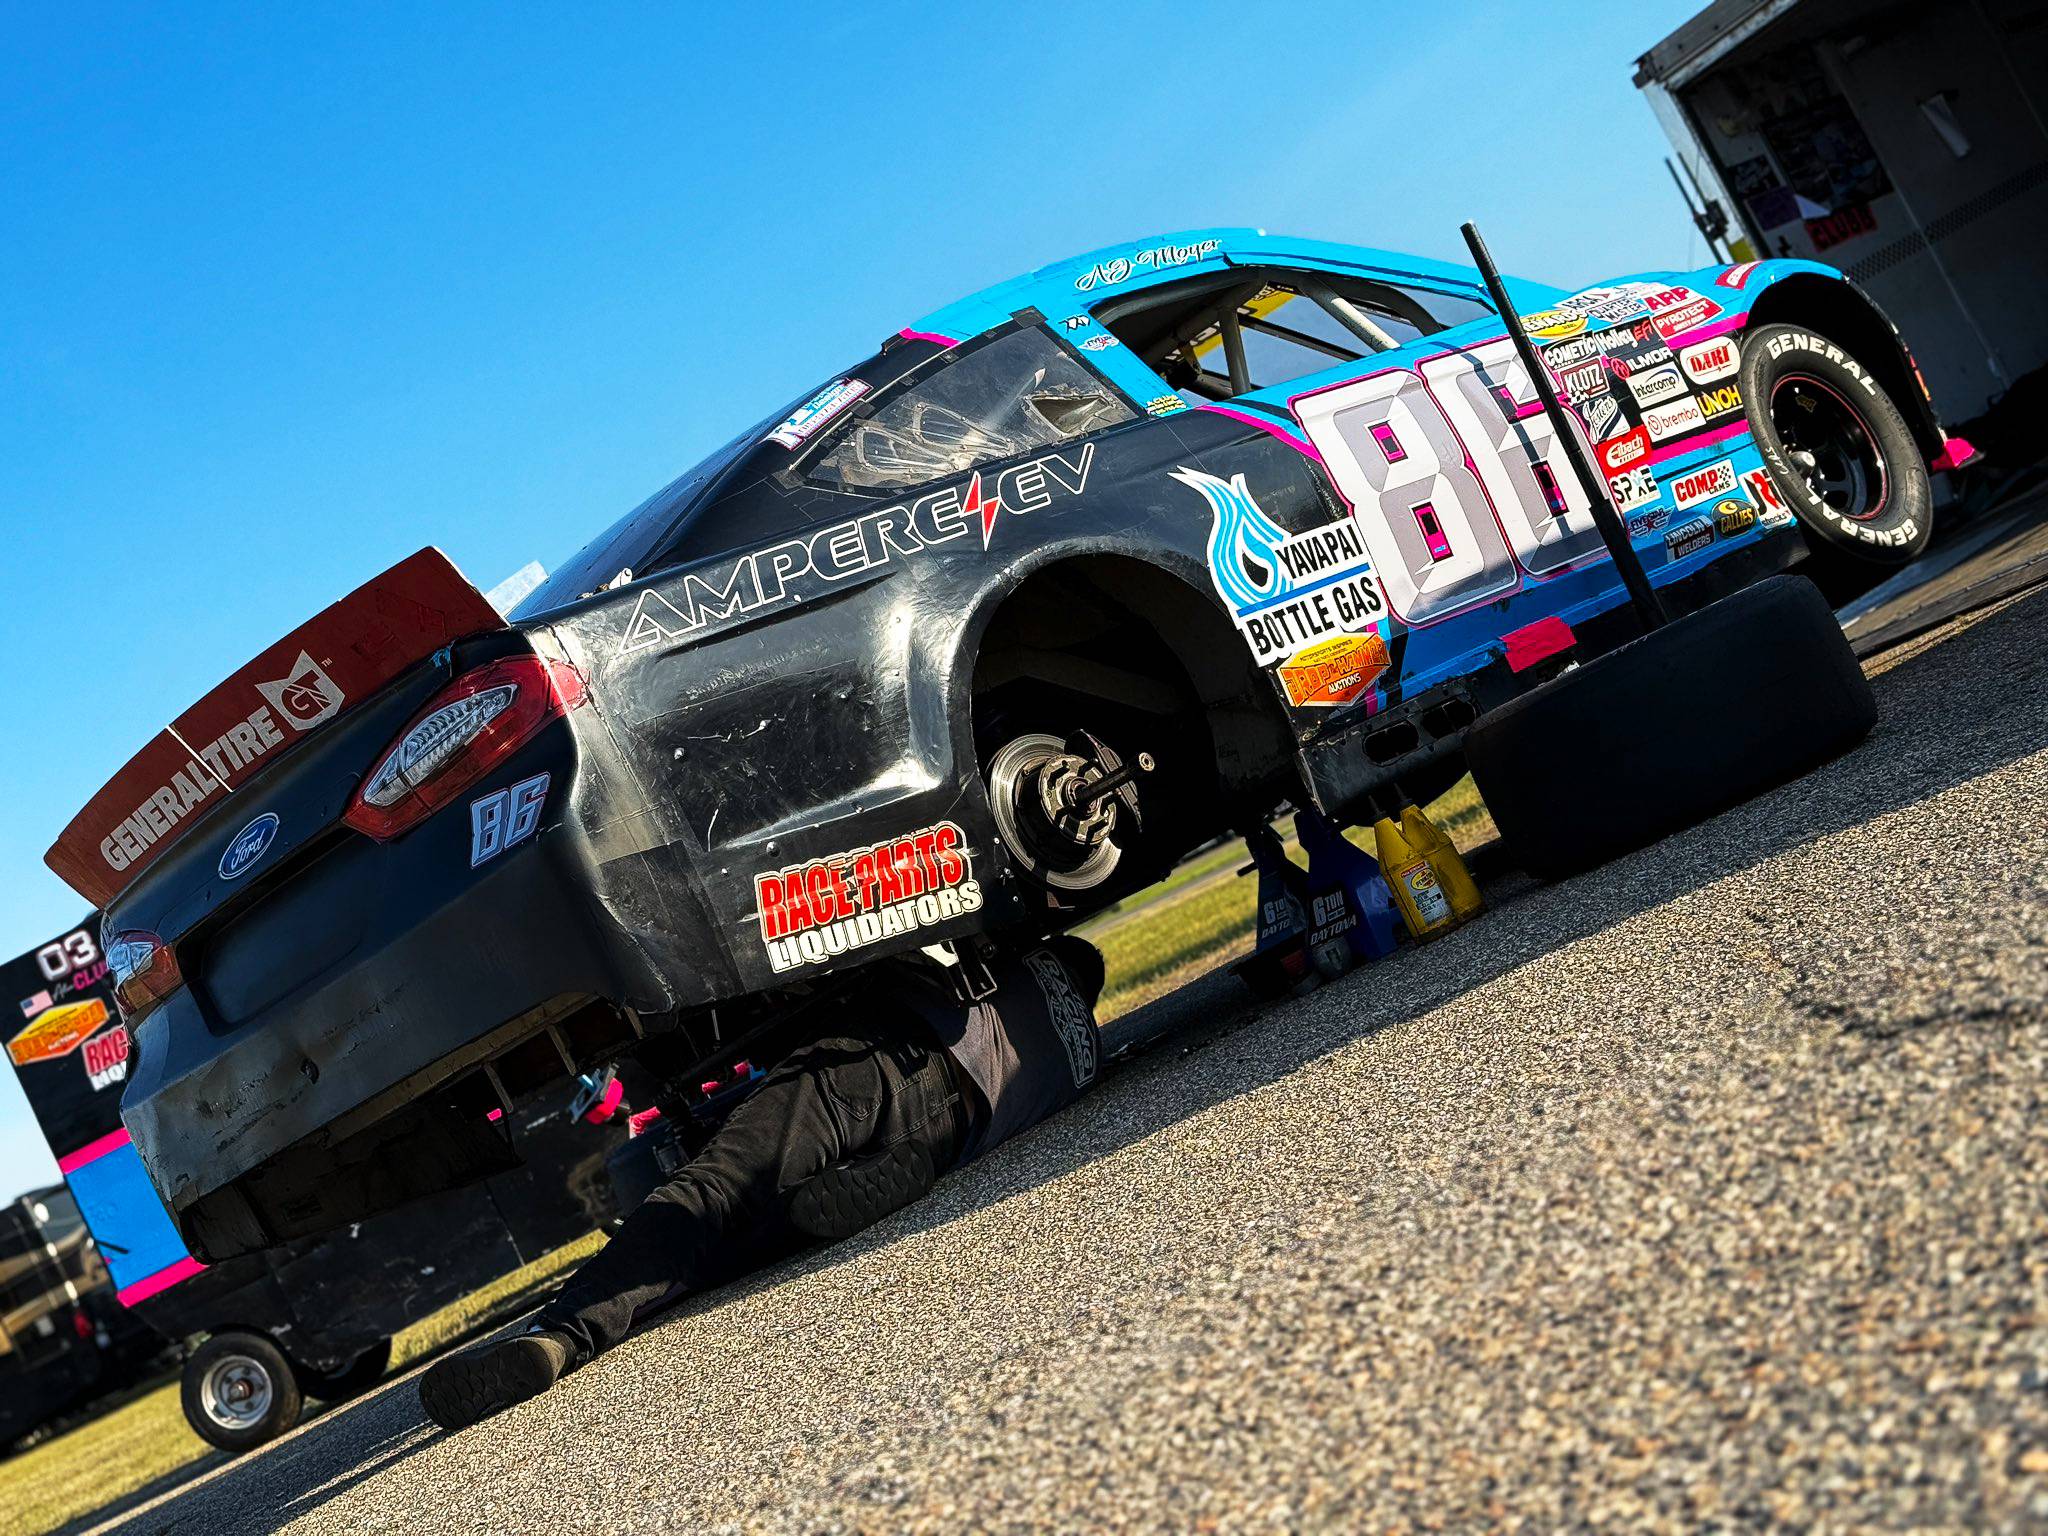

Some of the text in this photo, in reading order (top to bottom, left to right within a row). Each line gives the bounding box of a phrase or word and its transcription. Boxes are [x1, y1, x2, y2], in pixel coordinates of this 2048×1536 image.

[1605, 301, 1646, 322] MASTER
[1645, 285, 1691, 312] ARP
[1656, 298, 1709, 329] PYROTECT
[1543, 334, 1596, 367] COMETIC
[1594, 329, 1639, 350] Holley
[1628, 347, 1674, 372] ILMOR
[1766, 333, 1876, 396] GENERAL
[1563, 362, 1604, 394] KLOTZ
[1631, 375, 1677, 398] Intercomp
[1662, 407, 1700, 428] brembo
[1697, 384, 1742, 417] UNOH
[1606, 433, 1645, 468] Eibach
[1288, 335, 1630, 624] 86
[1675, 468, 1719, 503] COMP
[1708, 479, 1731, 496] CAMS
[1719, 508, 1755, 534] CALLIES
[1806, 478, 1919, 547] GENERAL
[1665, 515, 1713, 546] LINCOLN
[1677, 533, 1712, 557] WELDERS
[617, 442, 1096, 656] AMPERE EV
[1274, 523, 1364, 579] YAVAPAI
[1246, 576, 1382, 656] BOTTLE GAS
[1327, 673, 1363, 695] AUCTIONS
[99, 705, 286, 871] GENERAL TIRE
[469, 771, 551, 868] 86
[230, 825, 265, 872] Ford
[758, 825, 965, 939] RACE PARTS
[1262, 900, 1276, 925] 6
[1312, 896, 1327, 926] 6
[1325, 890, 1344, 915] TON
[766, 879, 984, 974] LIQUIDATORS
[1310, 914, 1357, 945] DAYTONA
[37, 929, 99, 981] 03
[1043, 959, 1093, 1069] RACING
[85, 1028, 130, 1075] RAC
